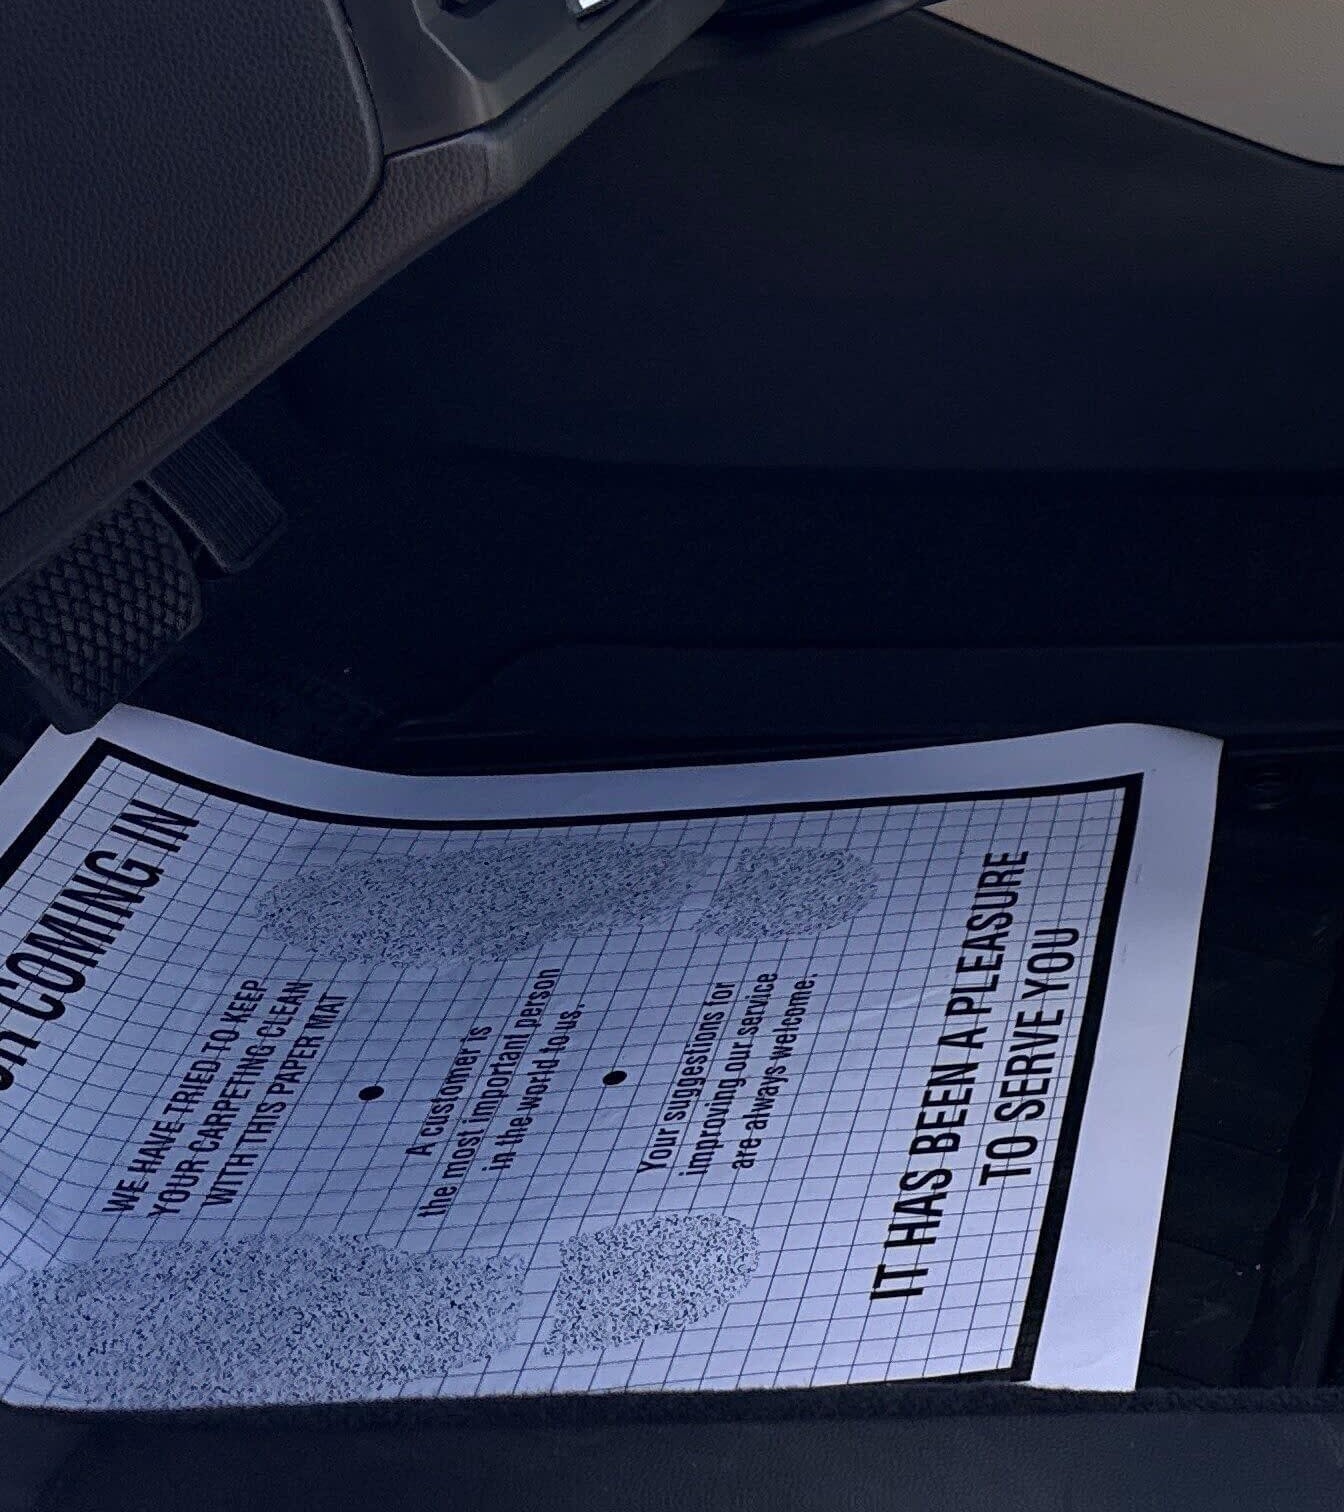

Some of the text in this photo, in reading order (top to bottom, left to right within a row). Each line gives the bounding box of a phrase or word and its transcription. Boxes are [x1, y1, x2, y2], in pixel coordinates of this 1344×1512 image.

[0, 797, 200, 1031] COMING IN
[102, 976, 268, 1211] WE HAVE TRIED TO KEEP
[146, 976, 314, 1216] YOUR CARPETING CLEAN
[201, 987, 348, 1205] WITH THIS PAPER MAT
[405, 1021, 493, 1156] A customer is
[417, 966, 562, 1218] the most important person
[482, 999, 586, 1170] in the world to us.
[636, 979, 735, 1171] Your suggestions for
[679, 969, 778, 1174] improving our service
[731, 968, 817, 1167] are always welcome.
[868, 850, 1030, 1299] IT HAS BEEN A PLEASURE
[978, 927, 1081, 1183] TO SERVE YOU
